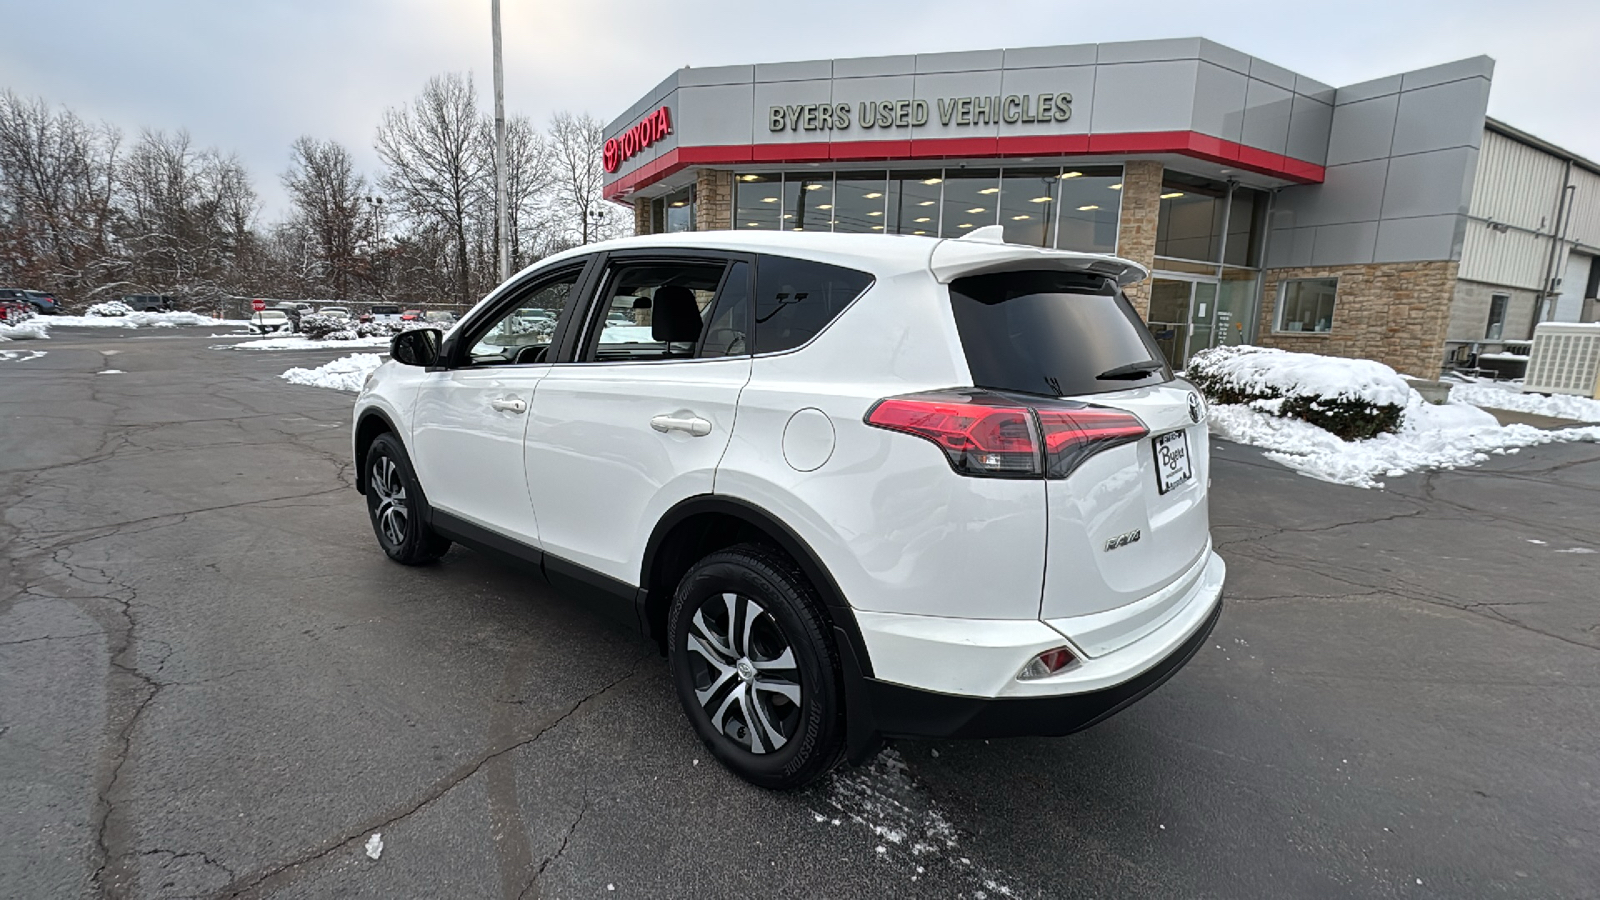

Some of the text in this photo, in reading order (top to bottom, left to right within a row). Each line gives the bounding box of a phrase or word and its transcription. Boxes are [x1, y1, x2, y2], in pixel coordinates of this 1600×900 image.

[618, 106, 670, 161] TOYOTA
[769, 92, 1073, 132] BYERS USED VEHICLES
